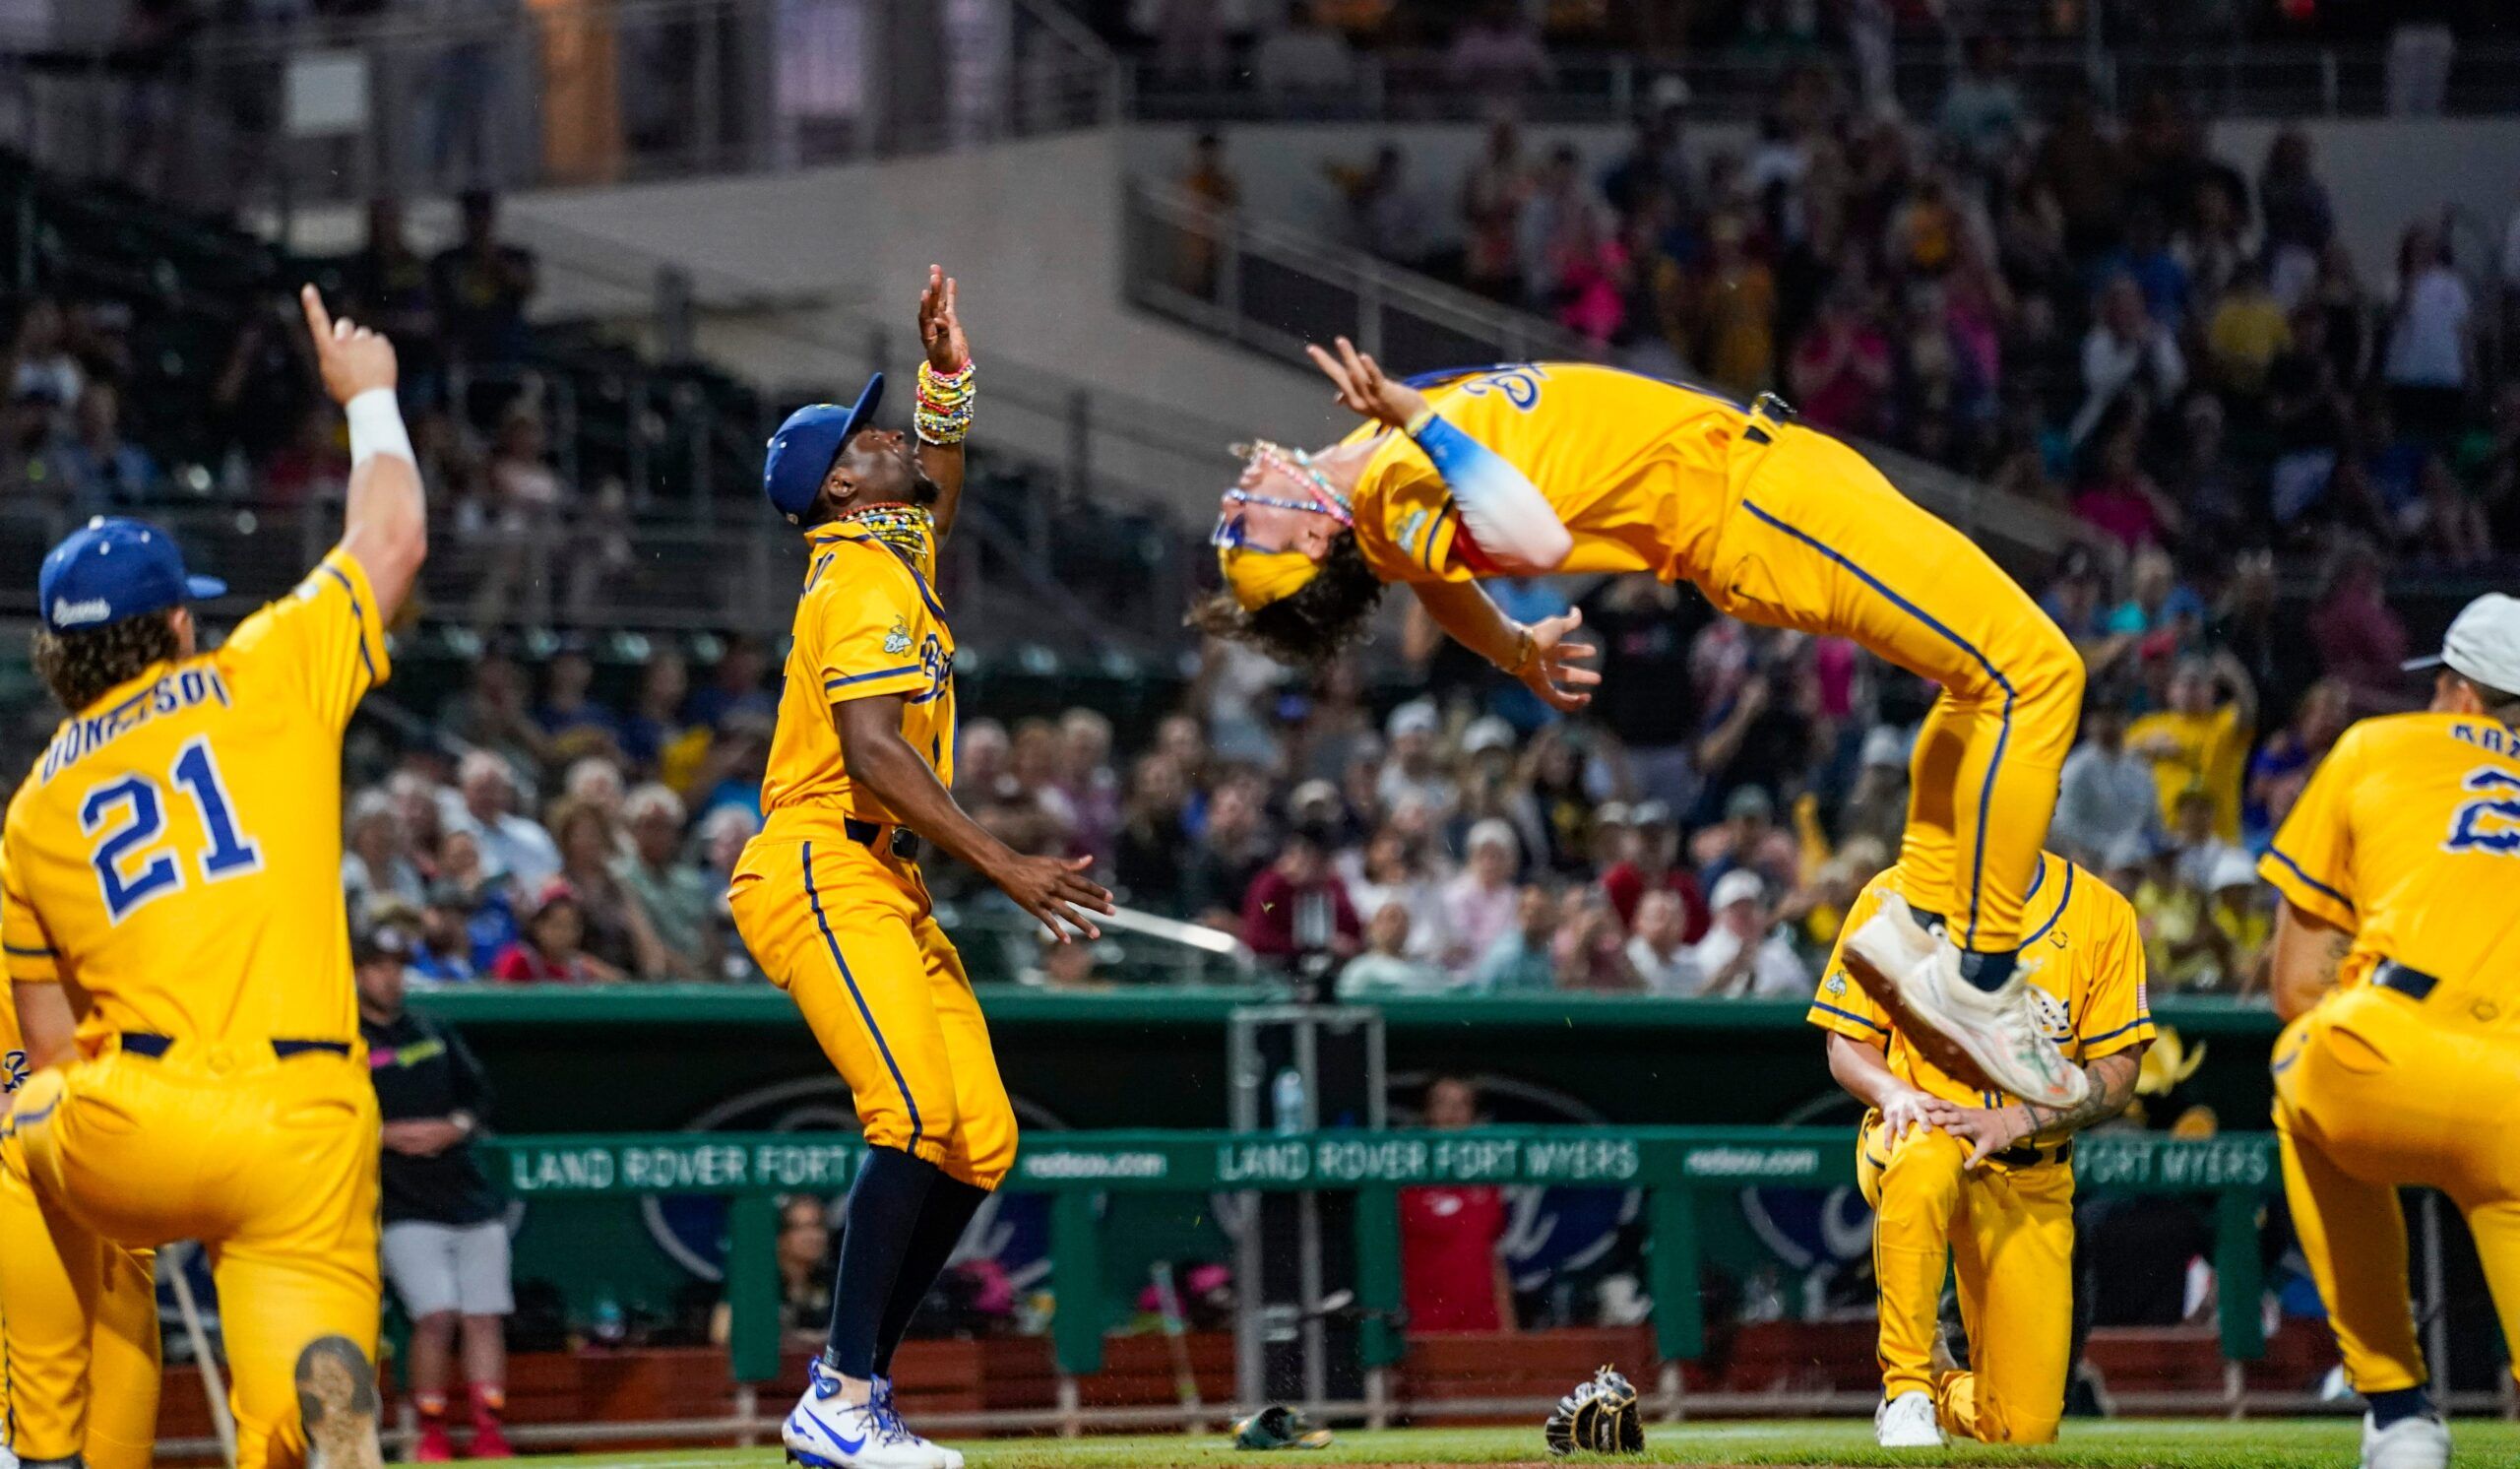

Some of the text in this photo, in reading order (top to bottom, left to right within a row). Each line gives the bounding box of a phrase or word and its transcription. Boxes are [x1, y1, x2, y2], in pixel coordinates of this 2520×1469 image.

[79, 734, 264, 927] 21
[511, 1147, 615, 1189] LAND
[621, 1146, 748, 1186] ROVER
[756, 1144, 850, 1185] FORT
[1218, 1138, 1640, 1182] LAND ROVER FORT MYERS
[2161, 1139, 2269, 1184] MYERS
